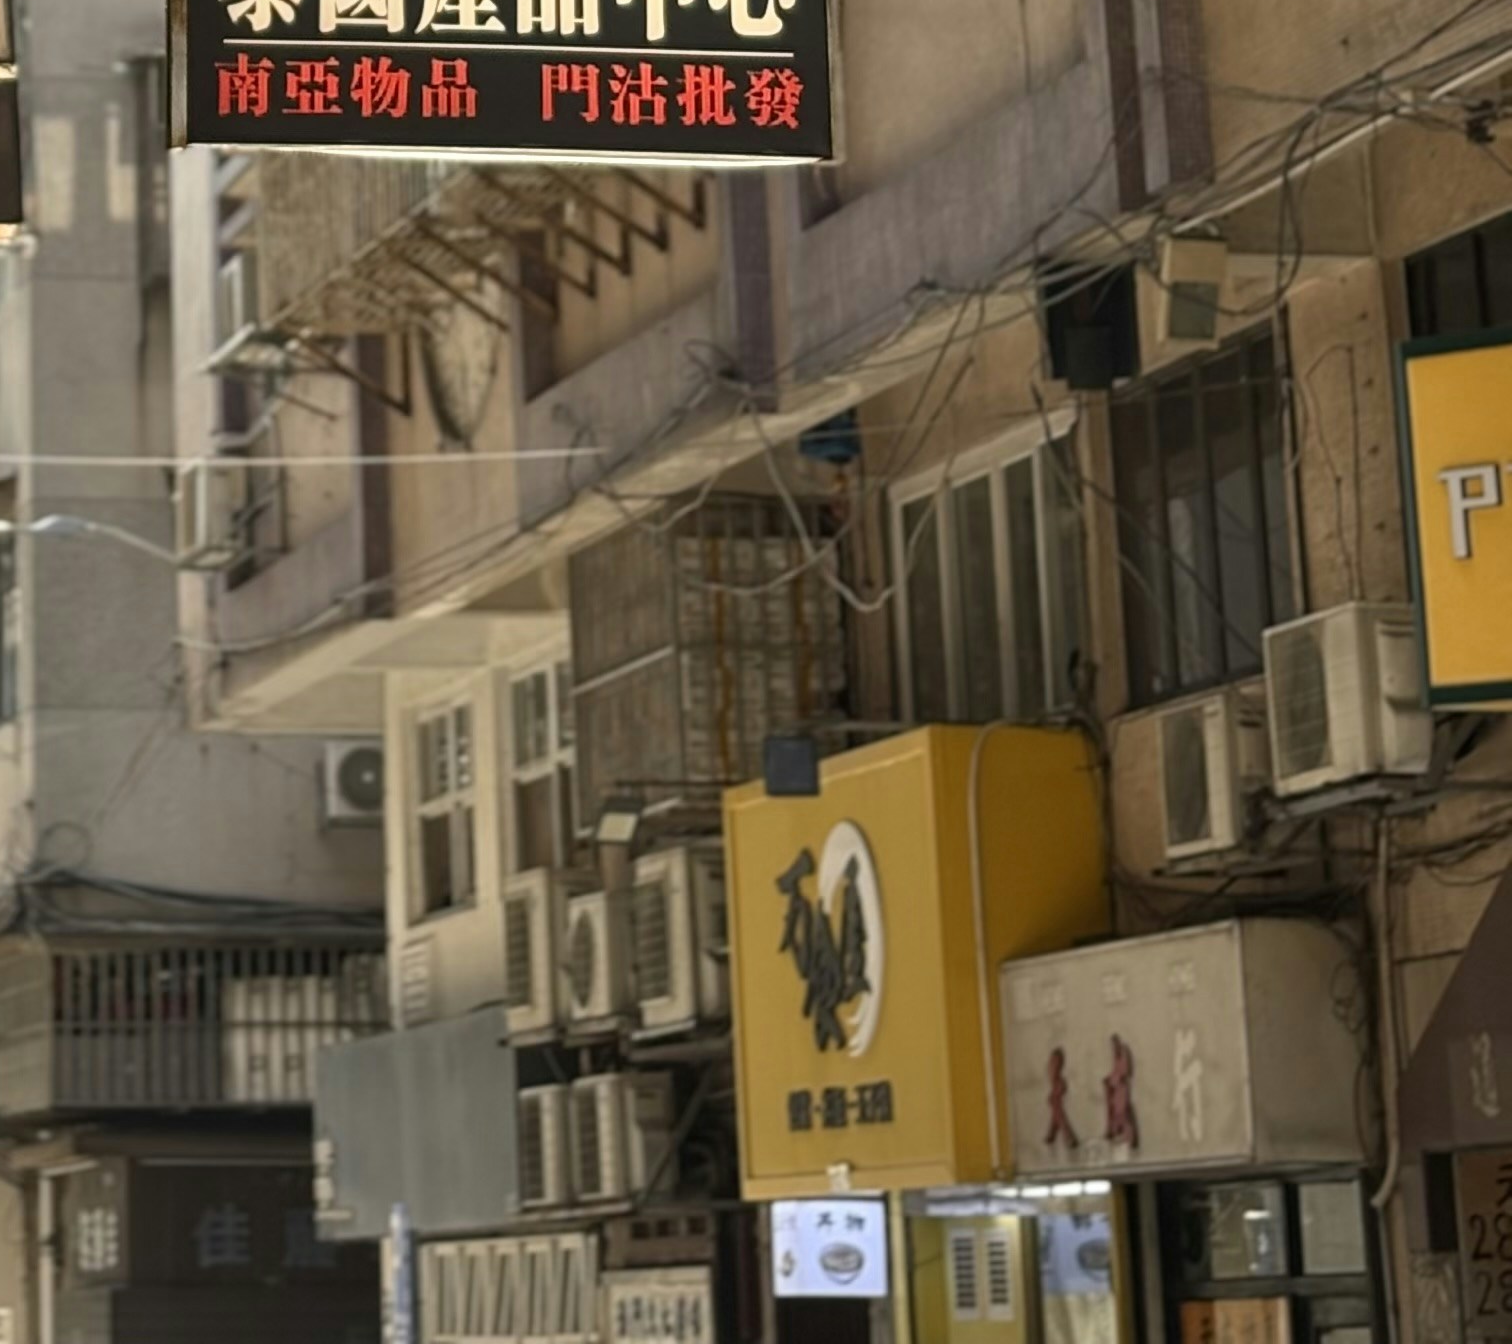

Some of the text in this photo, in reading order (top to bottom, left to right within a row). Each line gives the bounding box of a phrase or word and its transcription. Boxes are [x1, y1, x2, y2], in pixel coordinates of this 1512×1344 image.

[214, 53, 805, 130] 南亞物品 門沽批發
